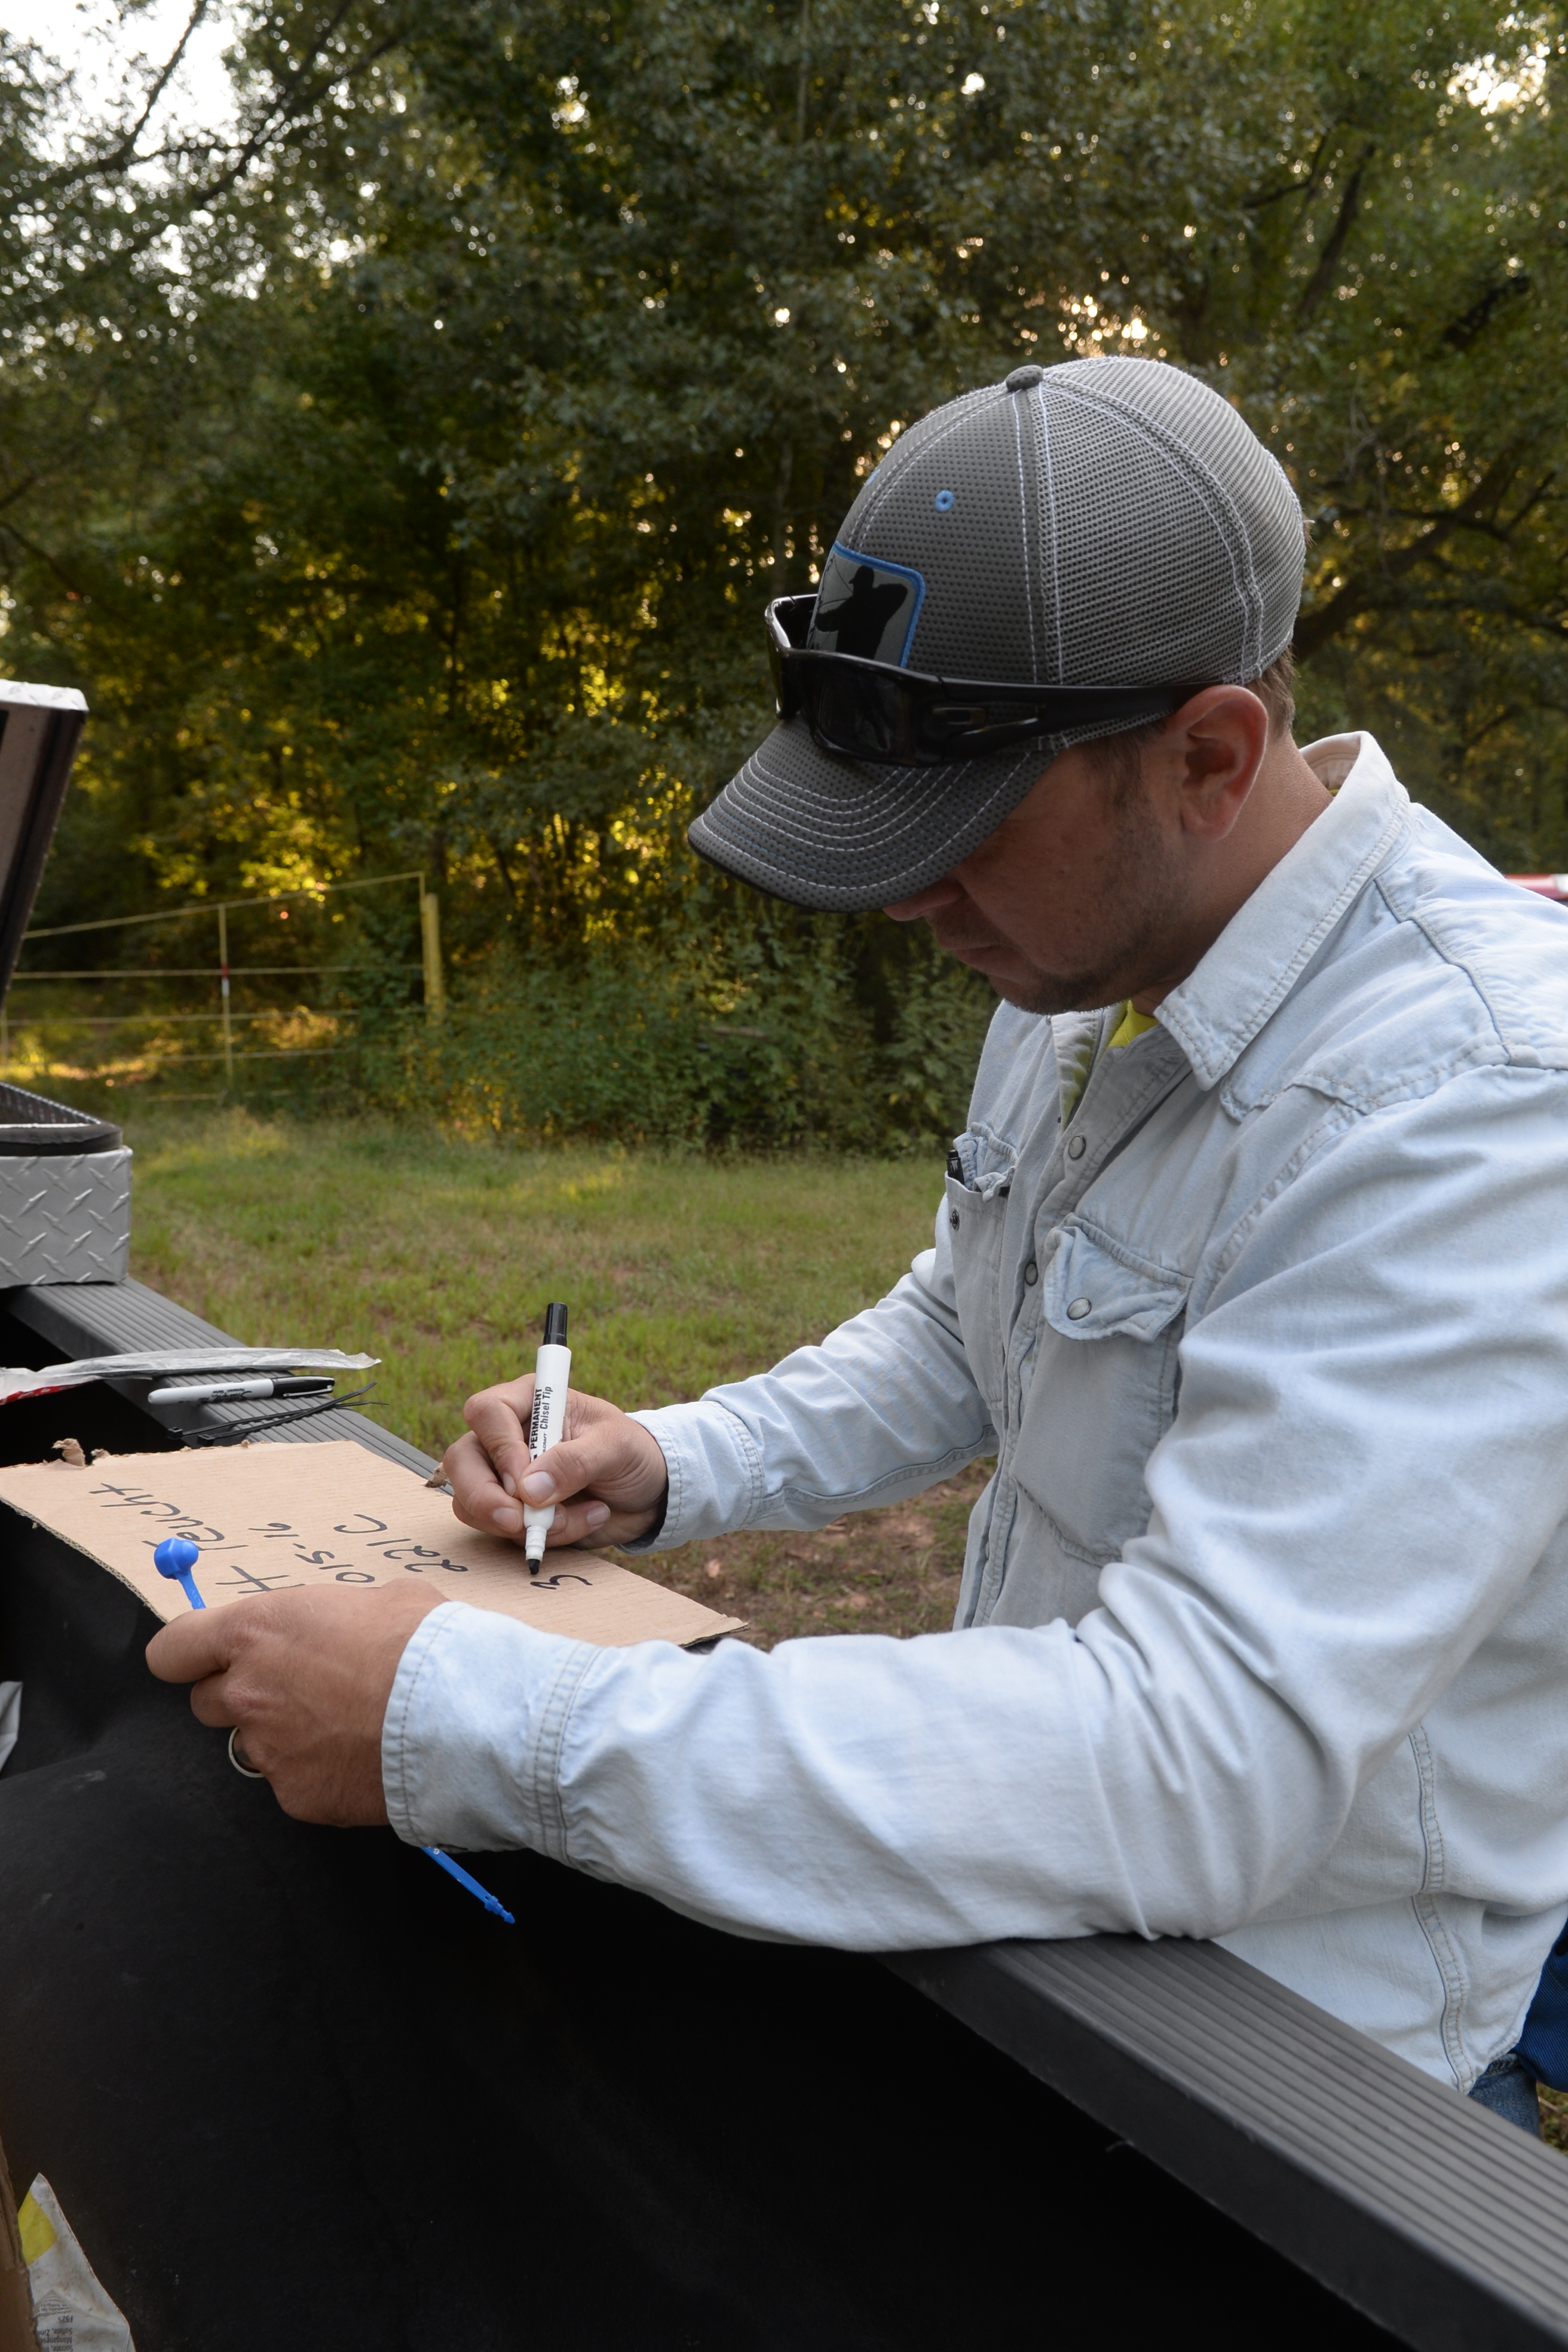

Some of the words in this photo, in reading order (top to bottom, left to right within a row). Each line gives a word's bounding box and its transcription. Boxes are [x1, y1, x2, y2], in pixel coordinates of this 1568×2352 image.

[542, 1386, 553, 1399] Tip
[530, 1388, 542, 1450] PERMANENT
[540, 1402, 550, 1429] Chisel
[248, 1522, 382, 1588] 015-16
[530, 1574, 593, 1590] 3
